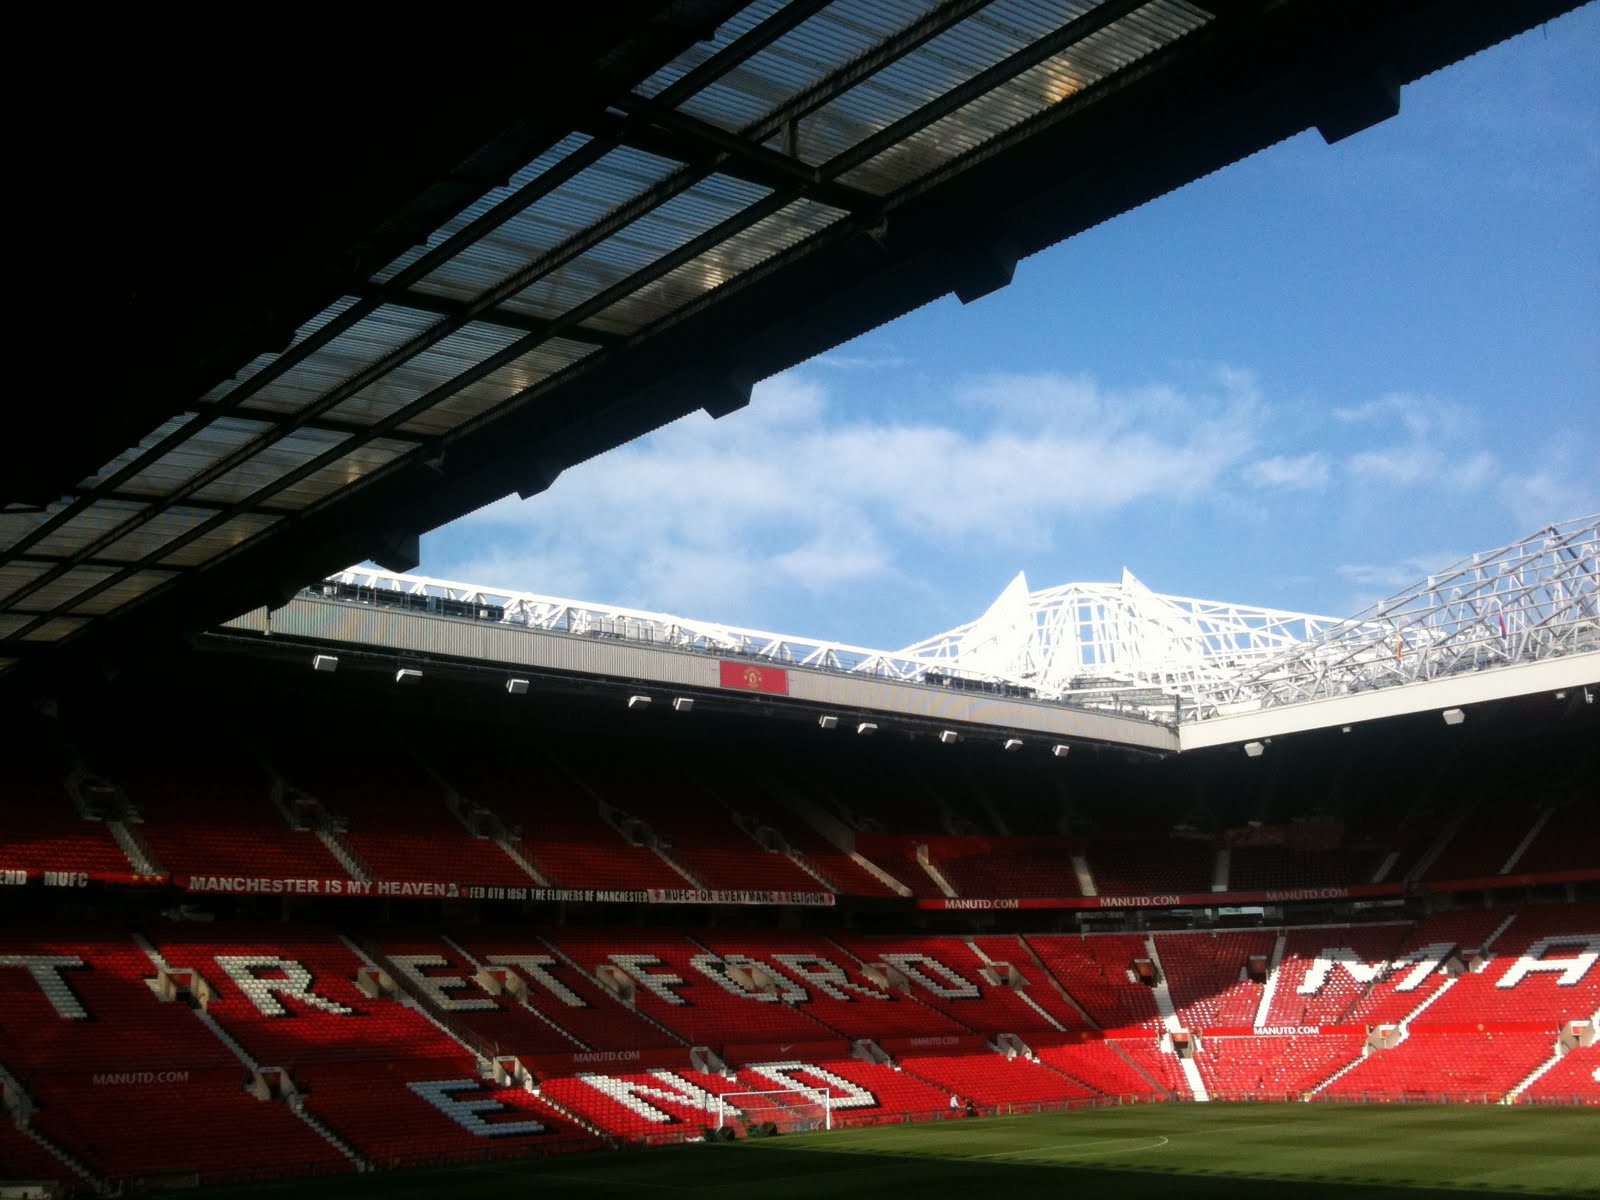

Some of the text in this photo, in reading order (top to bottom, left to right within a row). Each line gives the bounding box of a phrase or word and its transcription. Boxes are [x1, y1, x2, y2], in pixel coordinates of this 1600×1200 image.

[43, 871, 89, 888] MUFC
[189, 876, 446, 897] MANCHESTER IS MY HEAVEN
[531, 889, 546, 901] THE
[548, 889, 583, 902] FLOWERS
[596, 890, 648, 903] MANCHESTER
[1100, 895, 1180, 907] MANUTD.COM
[1265, 887, 1349, 902] MANUTD.COM
[945, 899, 1019, 910] MANUTD.COM
[1253, 1025, 1320, 1036] MANUTD.COM
[910, 1035, 960, 1048] MANUTD.COM
[573, 1050, 641, 1064] MANUTD.COM
[92, 1070, 190, 1087] MANUTD.COM
